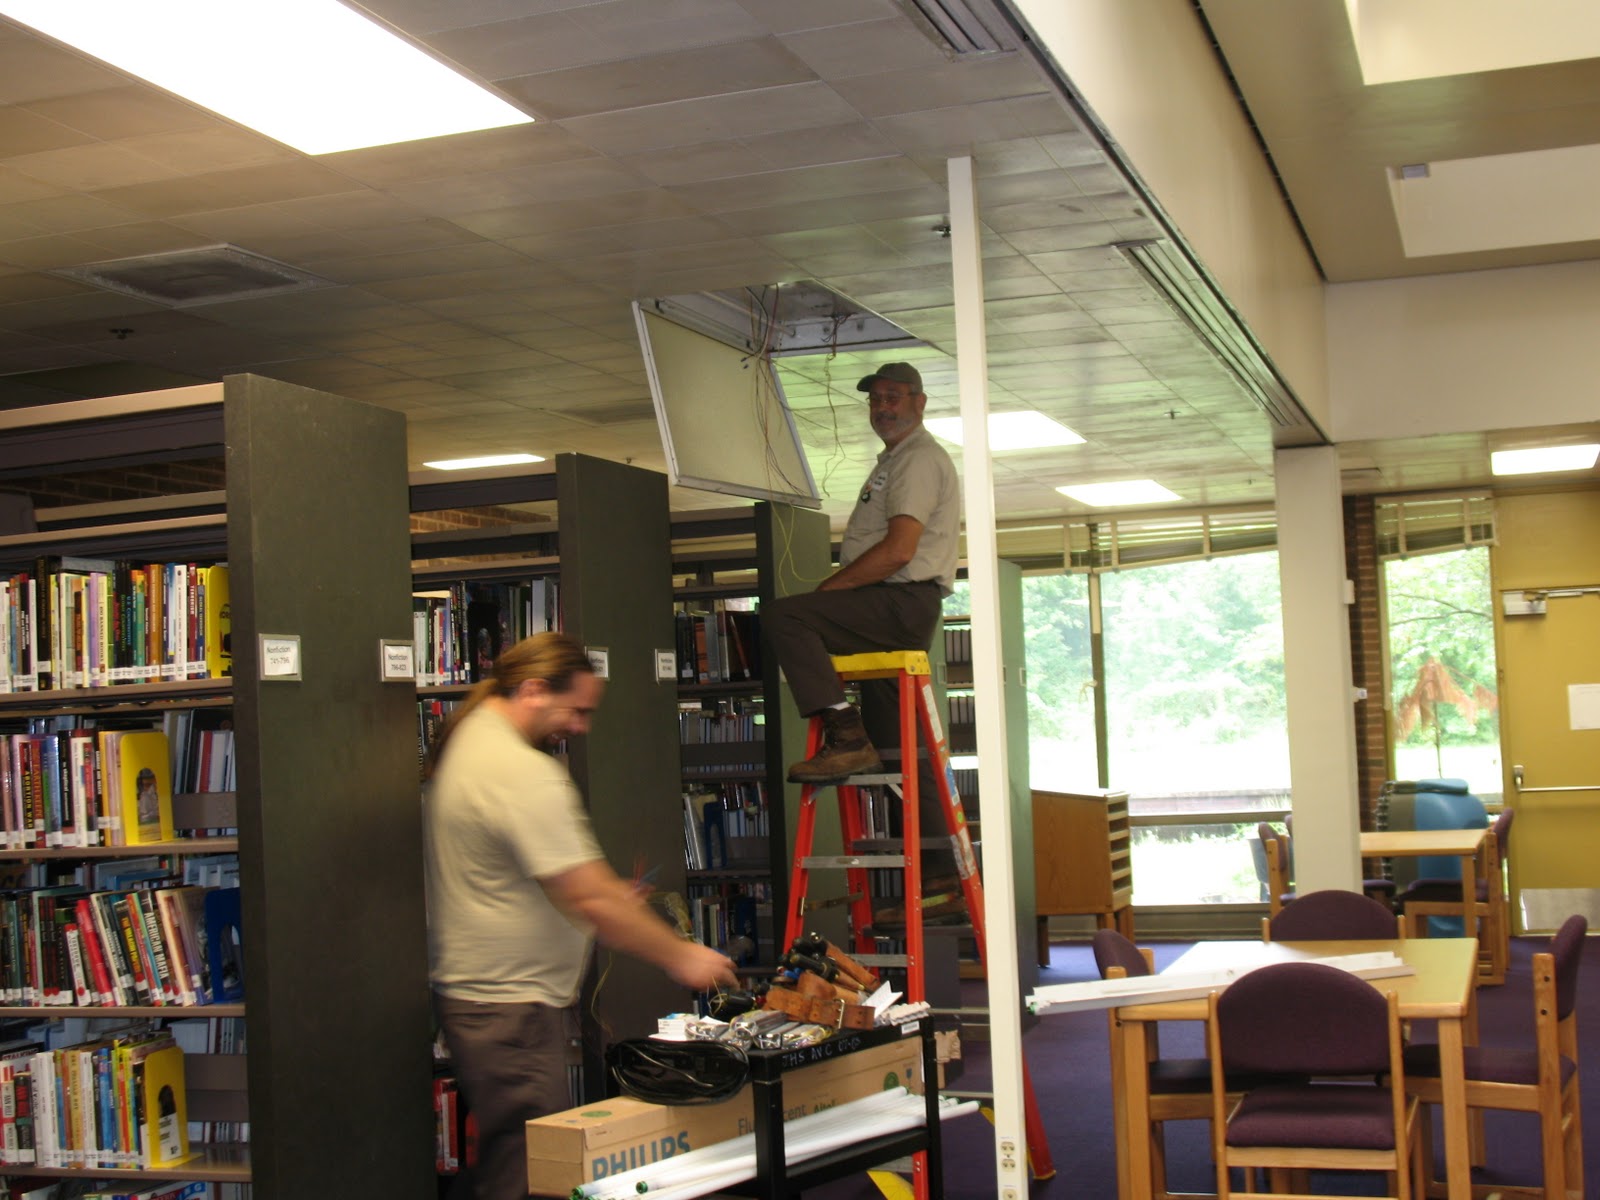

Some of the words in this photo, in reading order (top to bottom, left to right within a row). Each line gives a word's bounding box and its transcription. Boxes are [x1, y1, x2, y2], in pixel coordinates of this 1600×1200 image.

[24, 770, 32, 809] ABORTION
[143, 912, 164, 953] AMERICAN
[153, 953, 170, 979] MAFIA
